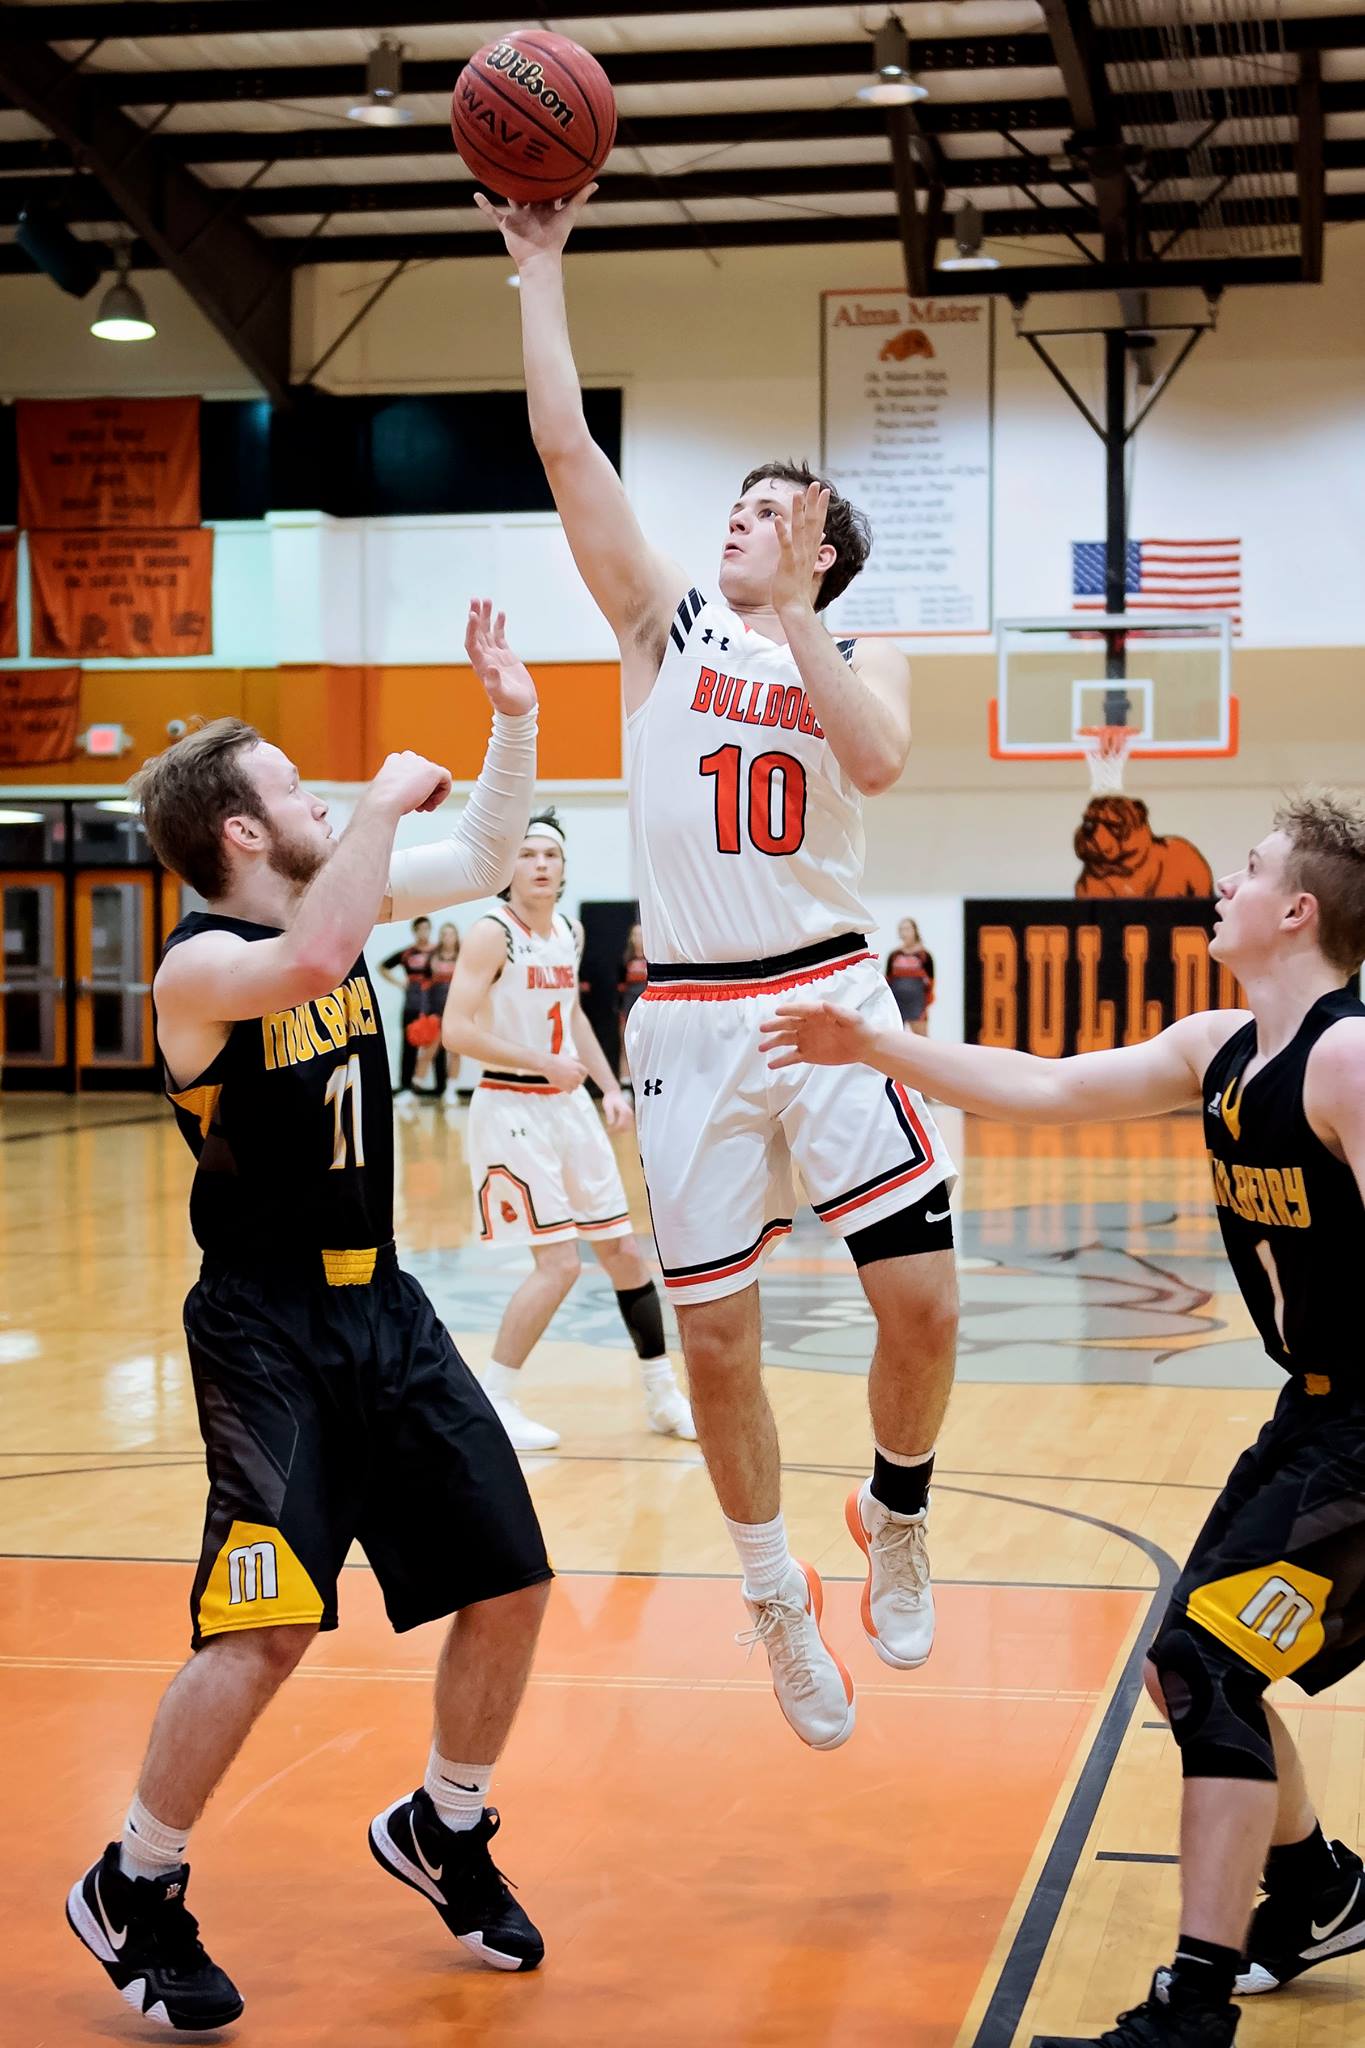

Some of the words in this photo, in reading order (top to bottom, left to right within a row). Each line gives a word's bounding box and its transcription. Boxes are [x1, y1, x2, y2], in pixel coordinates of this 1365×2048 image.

[461, 83, 549, 163] WAVE
[485, 43, 575, 129] Wilson
[832, 303, 901, 327] Alma
[907, 301, 982, 324] Mater
[699, 743, 807, 856] 10
[547, 1001, 564, 1055] 1
[324, 1053, 365, 1170] 11
[1255, 1239, 1291, 1354] 1
